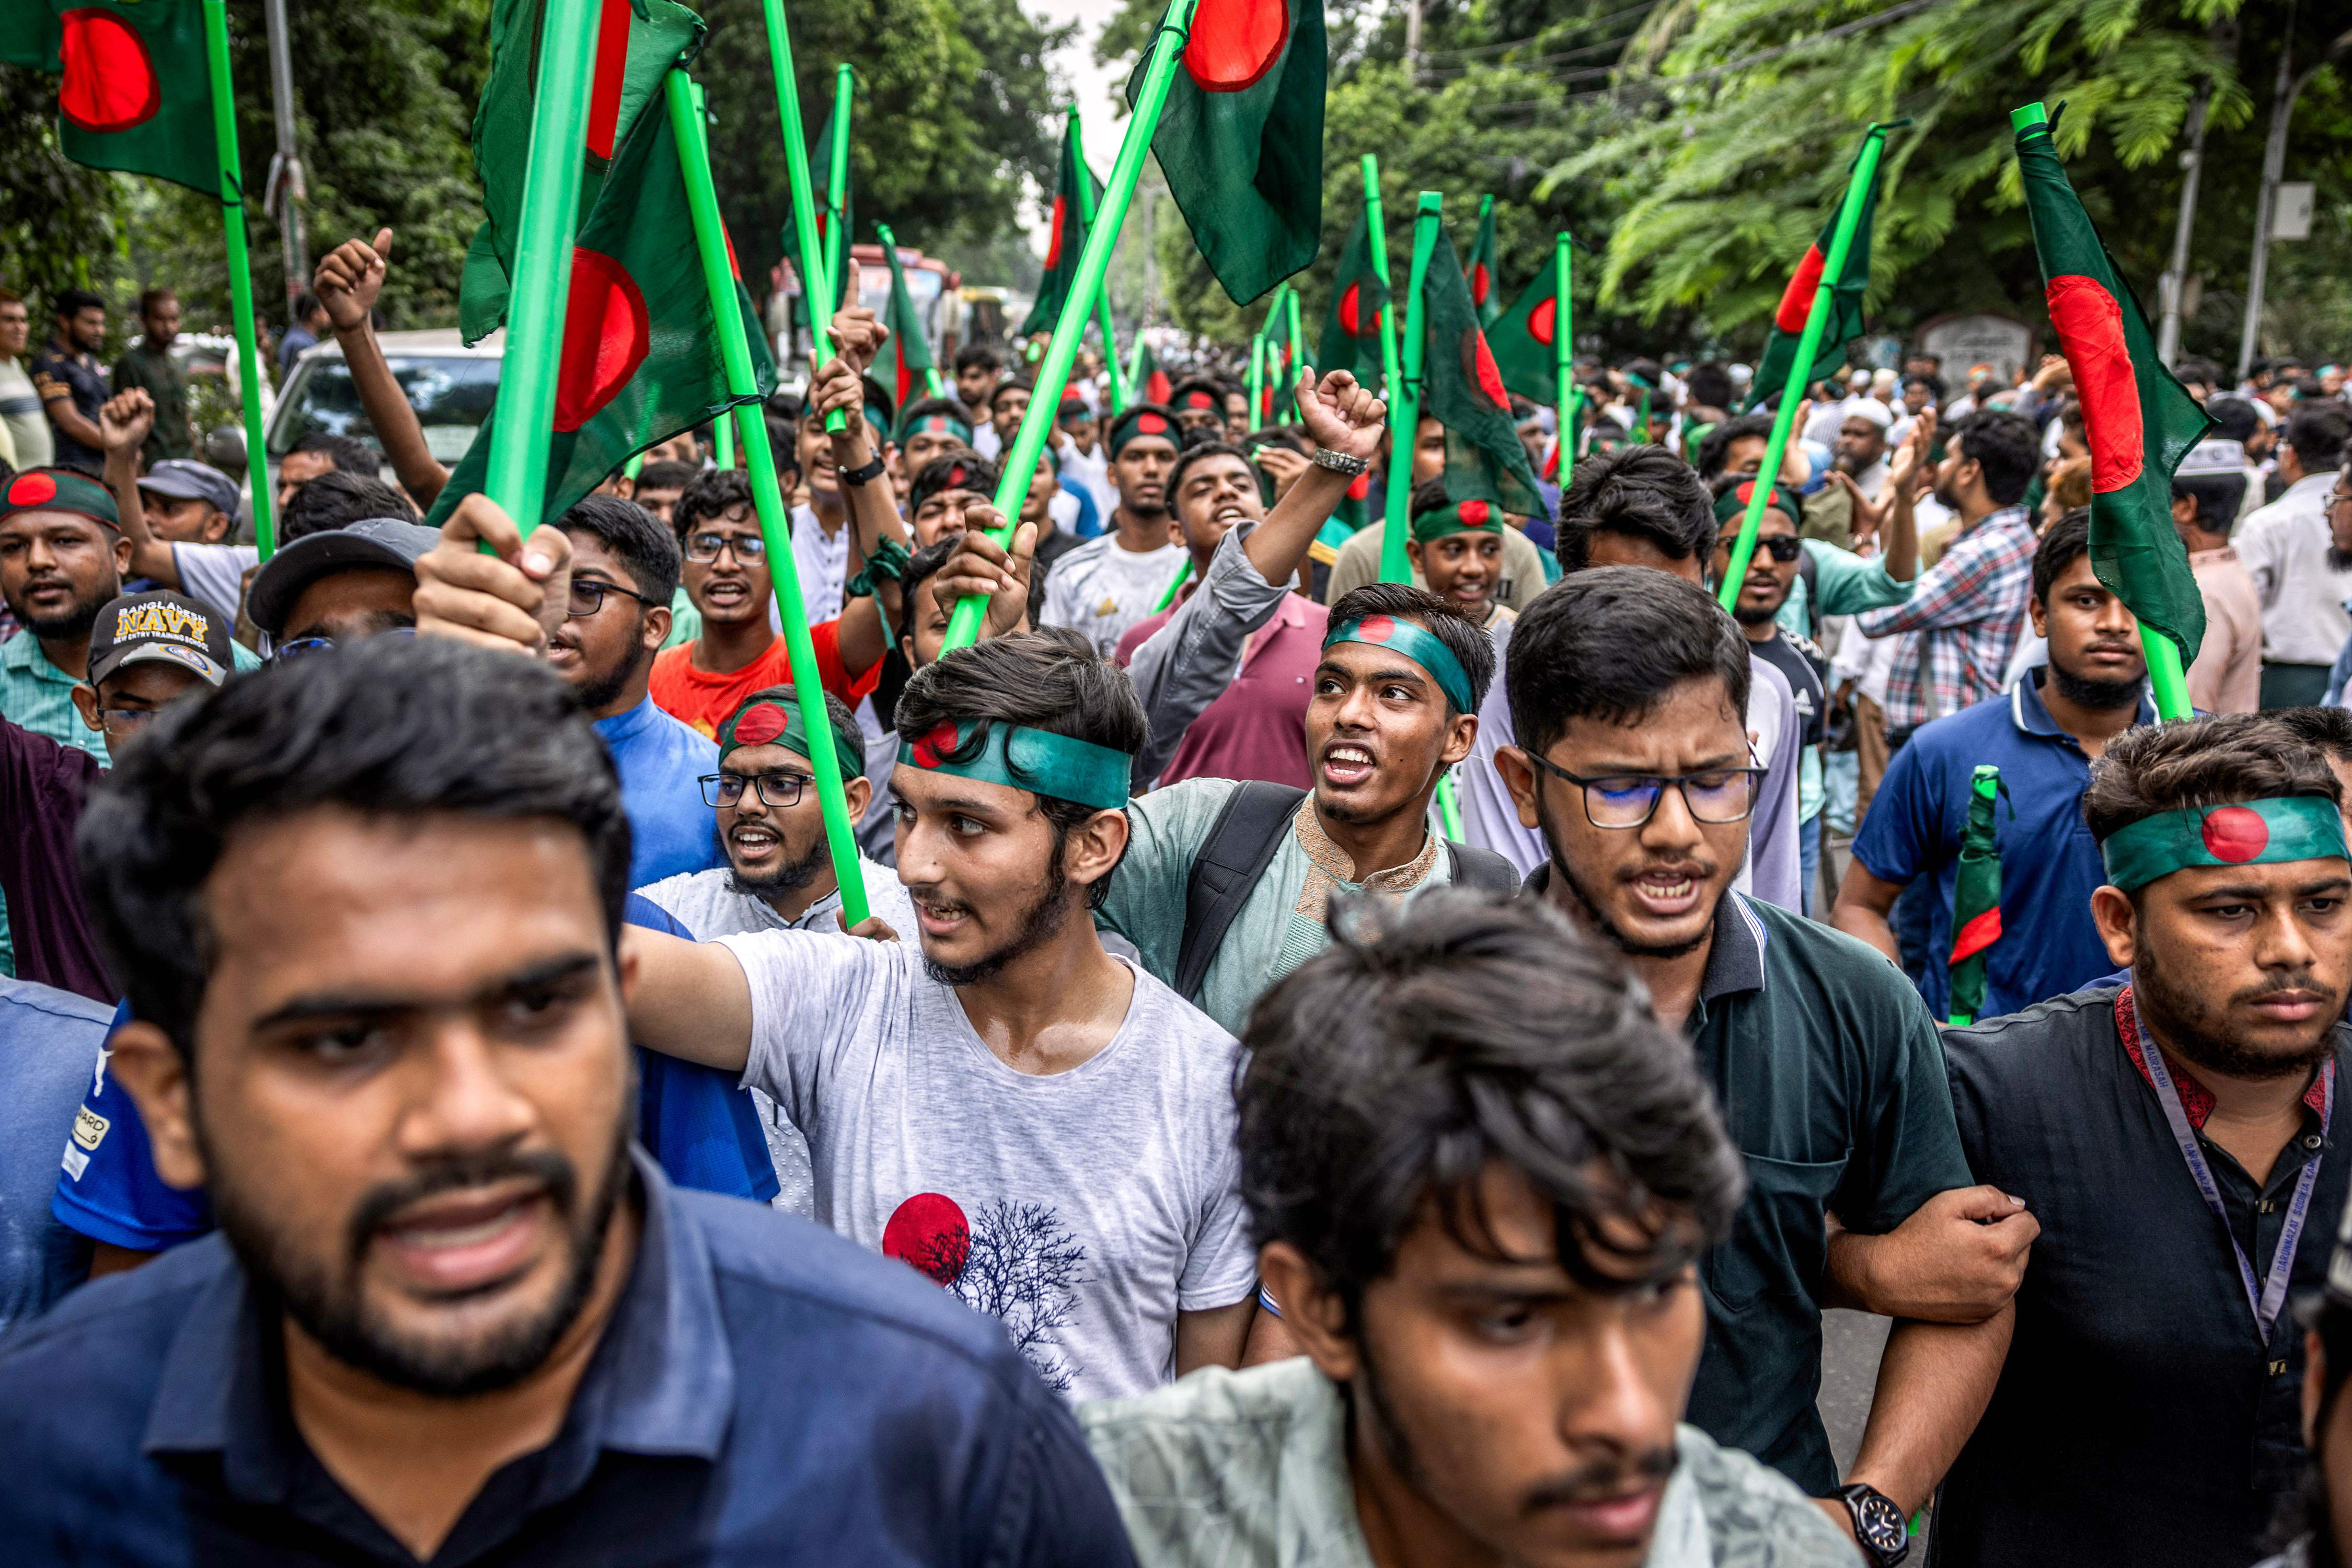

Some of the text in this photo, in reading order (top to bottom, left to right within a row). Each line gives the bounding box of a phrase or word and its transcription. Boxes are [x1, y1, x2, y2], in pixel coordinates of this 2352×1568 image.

[116, 608, 209, 642] NAVY
[119, 601, 207, 624] BANGLADESH
[113, 631, 209, 652] NEW ENTRY TRAINING SCHOOL
[2145, 1044, 2169, 1088] MADRASAH
[2184, 1143, 2215, 1195] DARUNNAZAT
[2277, 1219, 2300, 1272] DARUNNAZAT
[2293, 1183, 2310, 1216] SIDDIKIA
